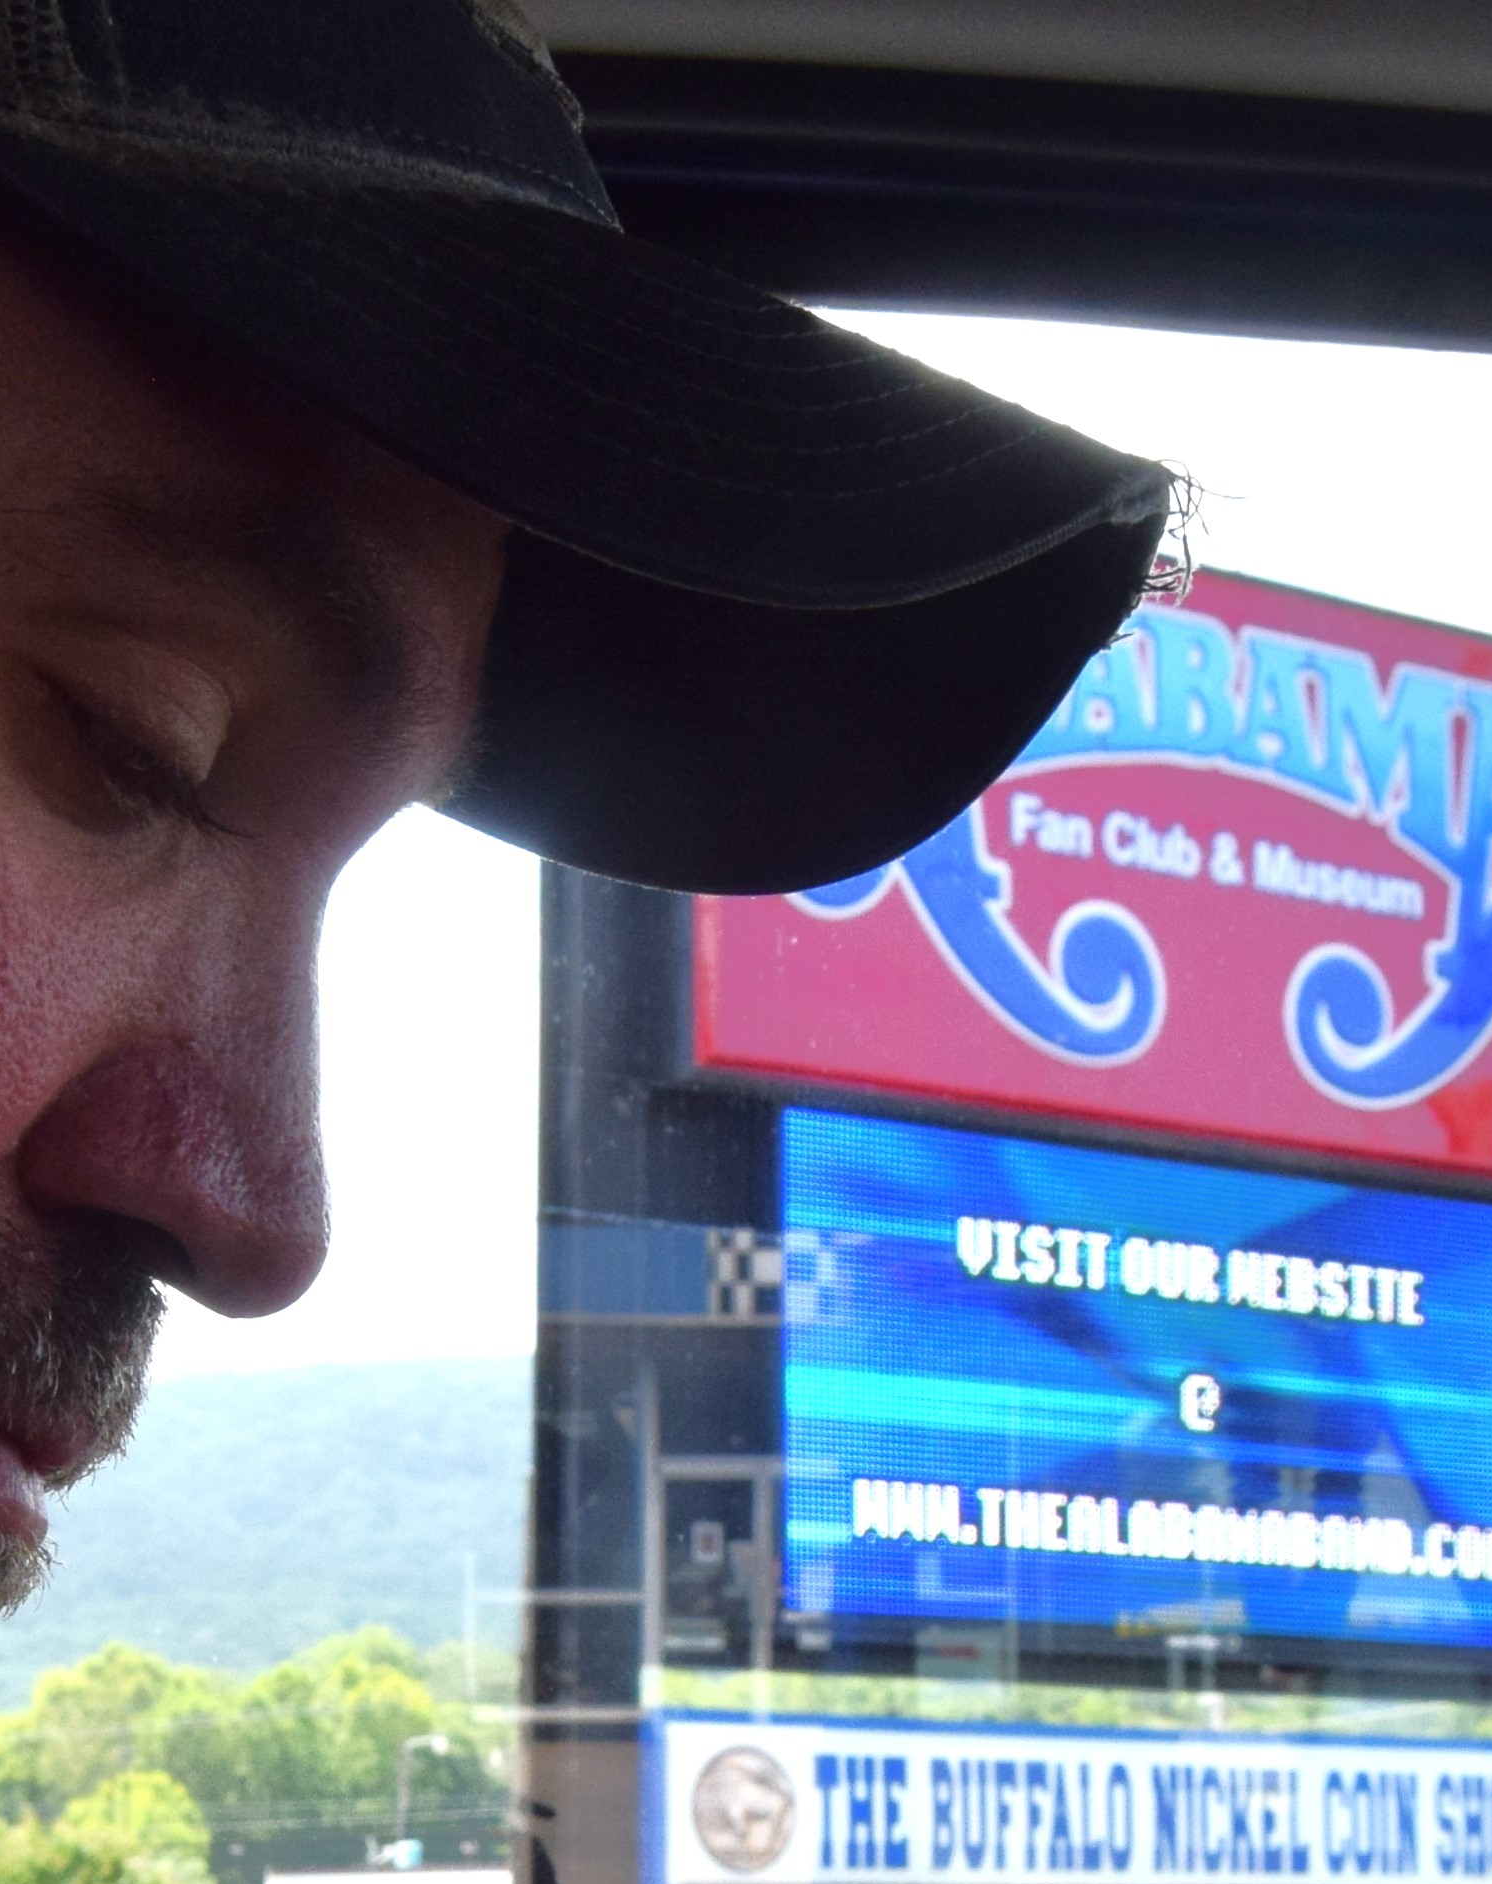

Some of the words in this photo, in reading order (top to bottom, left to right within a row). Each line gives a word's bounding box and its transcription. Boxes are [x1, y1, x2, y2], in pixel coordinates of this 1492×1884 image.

[1010, 791, 1094, 858] Fan
[1102, 809, 1202, 880] Club
[1209, 830, 1245, 887] &
[1252, 837, 1426, 921] Museum
[956, 1216, 1110, 1291] VISIT
[1120, 1236, 1220, 1303] OUR
[1227, 1250, 1425, 1326] WEBSITE
[1179, 1373, 1221, 1432] @
[813, 1753, 907, 1871] THE
[930, 1758, 1135, 1873] BUFFALO
[1150, 1764, 1310, 1876] NICKEL
[1323, 1768, 1418, 1876] COIN
